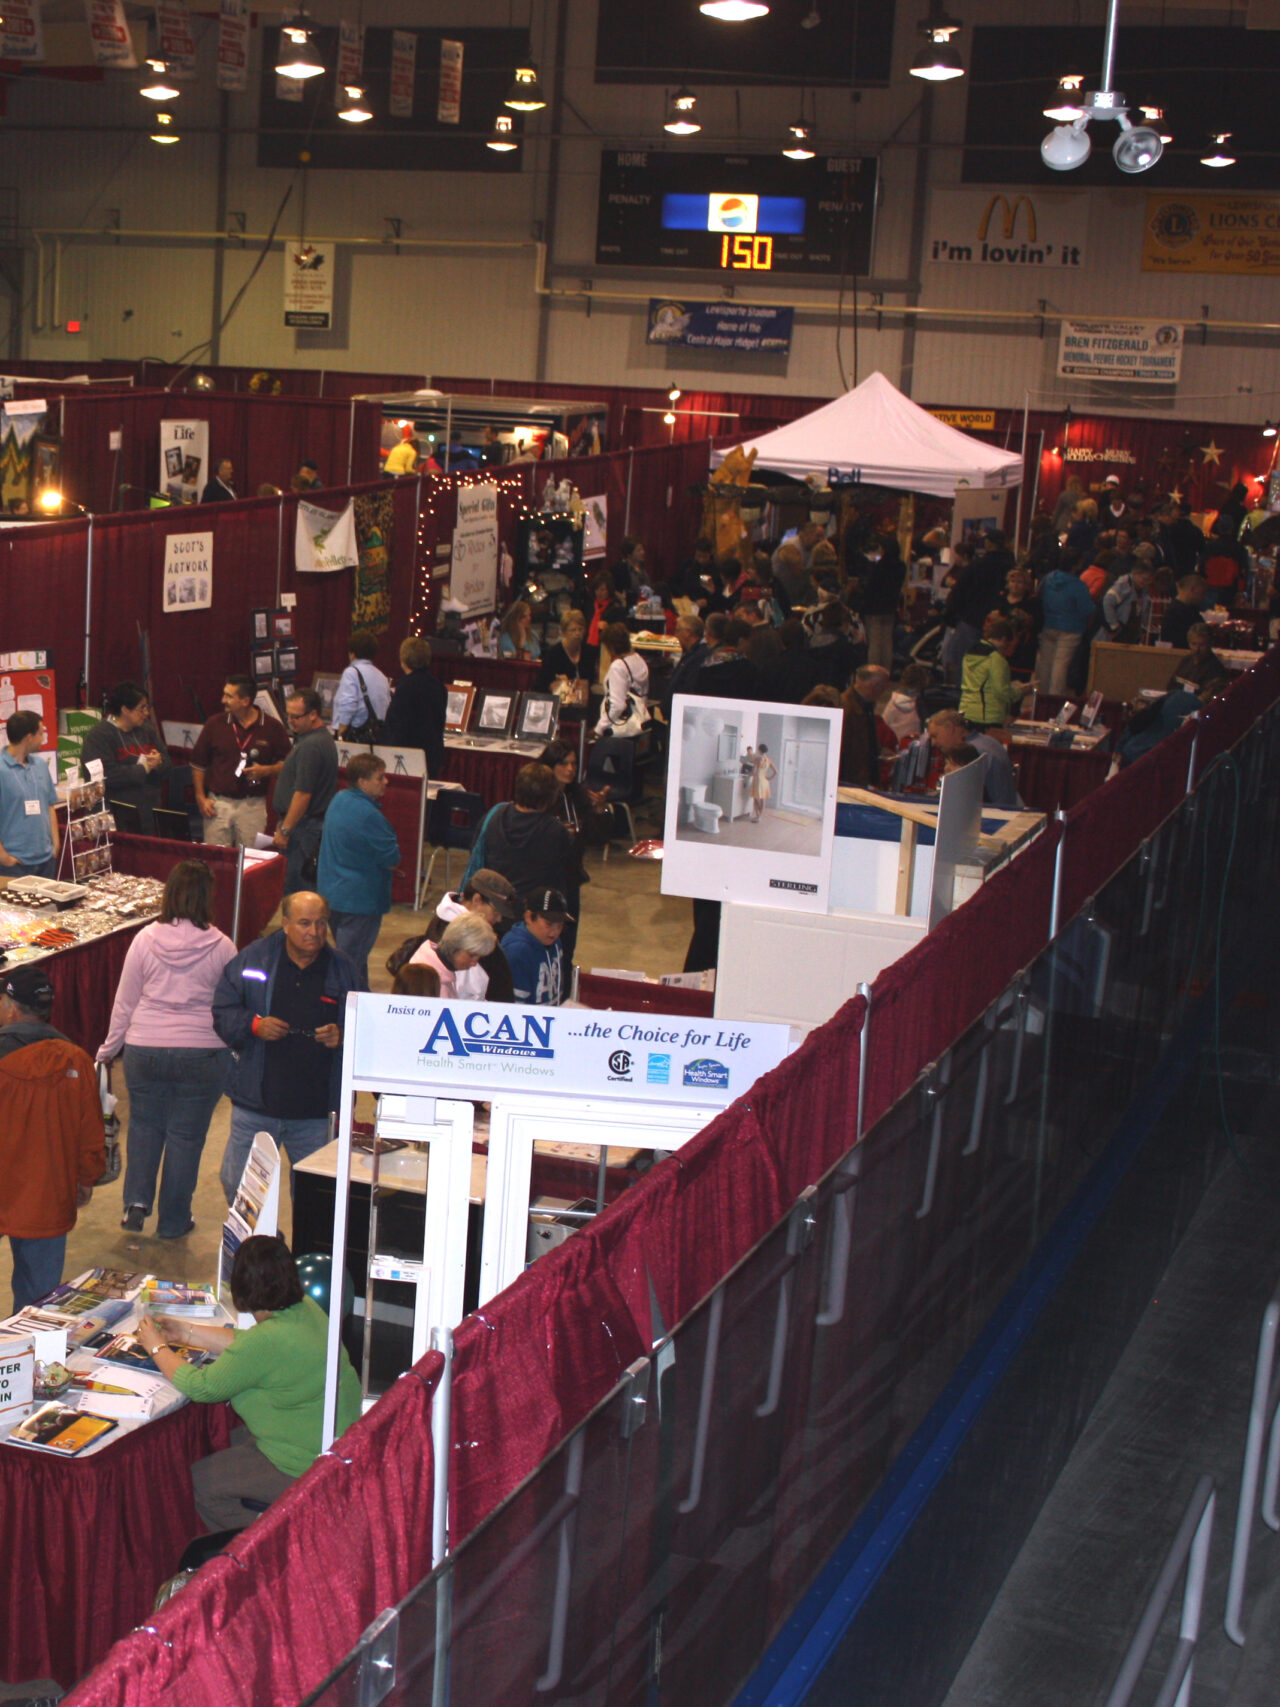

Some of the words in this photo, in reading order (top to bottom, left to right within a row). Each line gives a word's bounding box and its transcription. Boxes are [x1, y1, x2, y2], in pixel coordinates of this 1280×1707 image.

[617, 153, 648, 167] HOME
[826, 158, 862, 173] GUEST
[1209, 212, 1260, 229] LIONS
[721, 235, 773, 270] 150
[1061, 245, 1081, 266] it
[1065, 336, 1090, 348] BREN
[1091, 337, 1149, 351] FITZGERALD
[960, 413, 992, 423] WORLD
[173, 425, 196, 440] Life
[827, 466, 861, 483] Bell
[173, 540, 205, 554] SCOT'S
[167, 559, 209, 574] ARTWORK
[771, 880, 817, 893] STERLING
[387, 1004, 416, 1016] Insist
[418, 1008, 431, 1017] on
[419, 1007, 556, 1057] ACAN
[617, 1024, 680, 1044] Choice
[681, 1029, 711, 1049] for
[716, 1031, 752, 1052] Life
[481, 1044, 537, 1057] Windows
[416, 1055, 454, 1070] Health
[500, 1063, 556, 1077] Windows
[607, 1075, 634, 1083] Certified
[684, 1069, 707, 1077] Health
[707, 1071, 729, 1079] Smart
[691, 1076, 720, 1084] Windows
